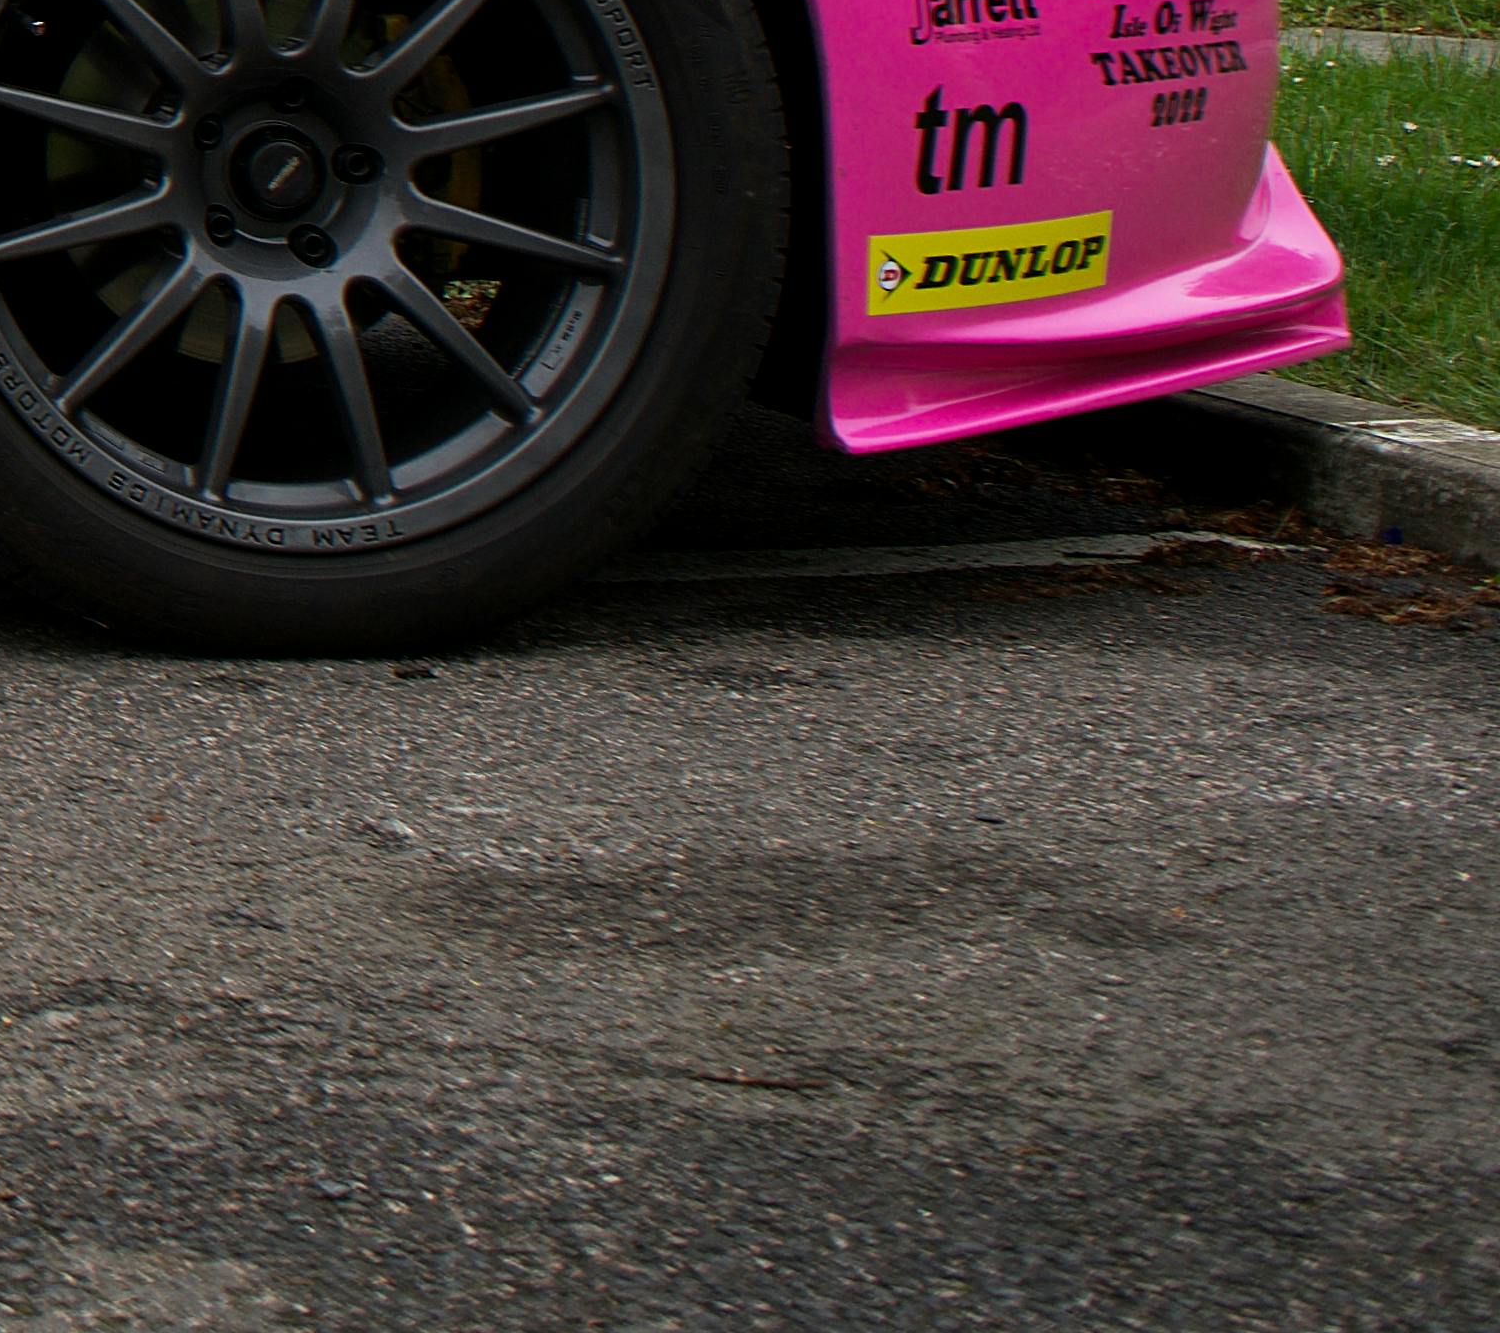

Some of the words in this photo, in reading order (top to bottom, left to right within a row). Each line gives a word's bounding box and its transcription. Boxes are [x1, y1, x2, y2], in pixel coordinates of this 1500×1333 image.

[1090, 39, 1249, 86] TAKEOVER
[914, 84, 1028, 195] tm
[914, 235, 1106, 290] DUNLOP
[106, 471, 285, 547] DYNAMICS
[312, 520, 403, 546] TEAM
